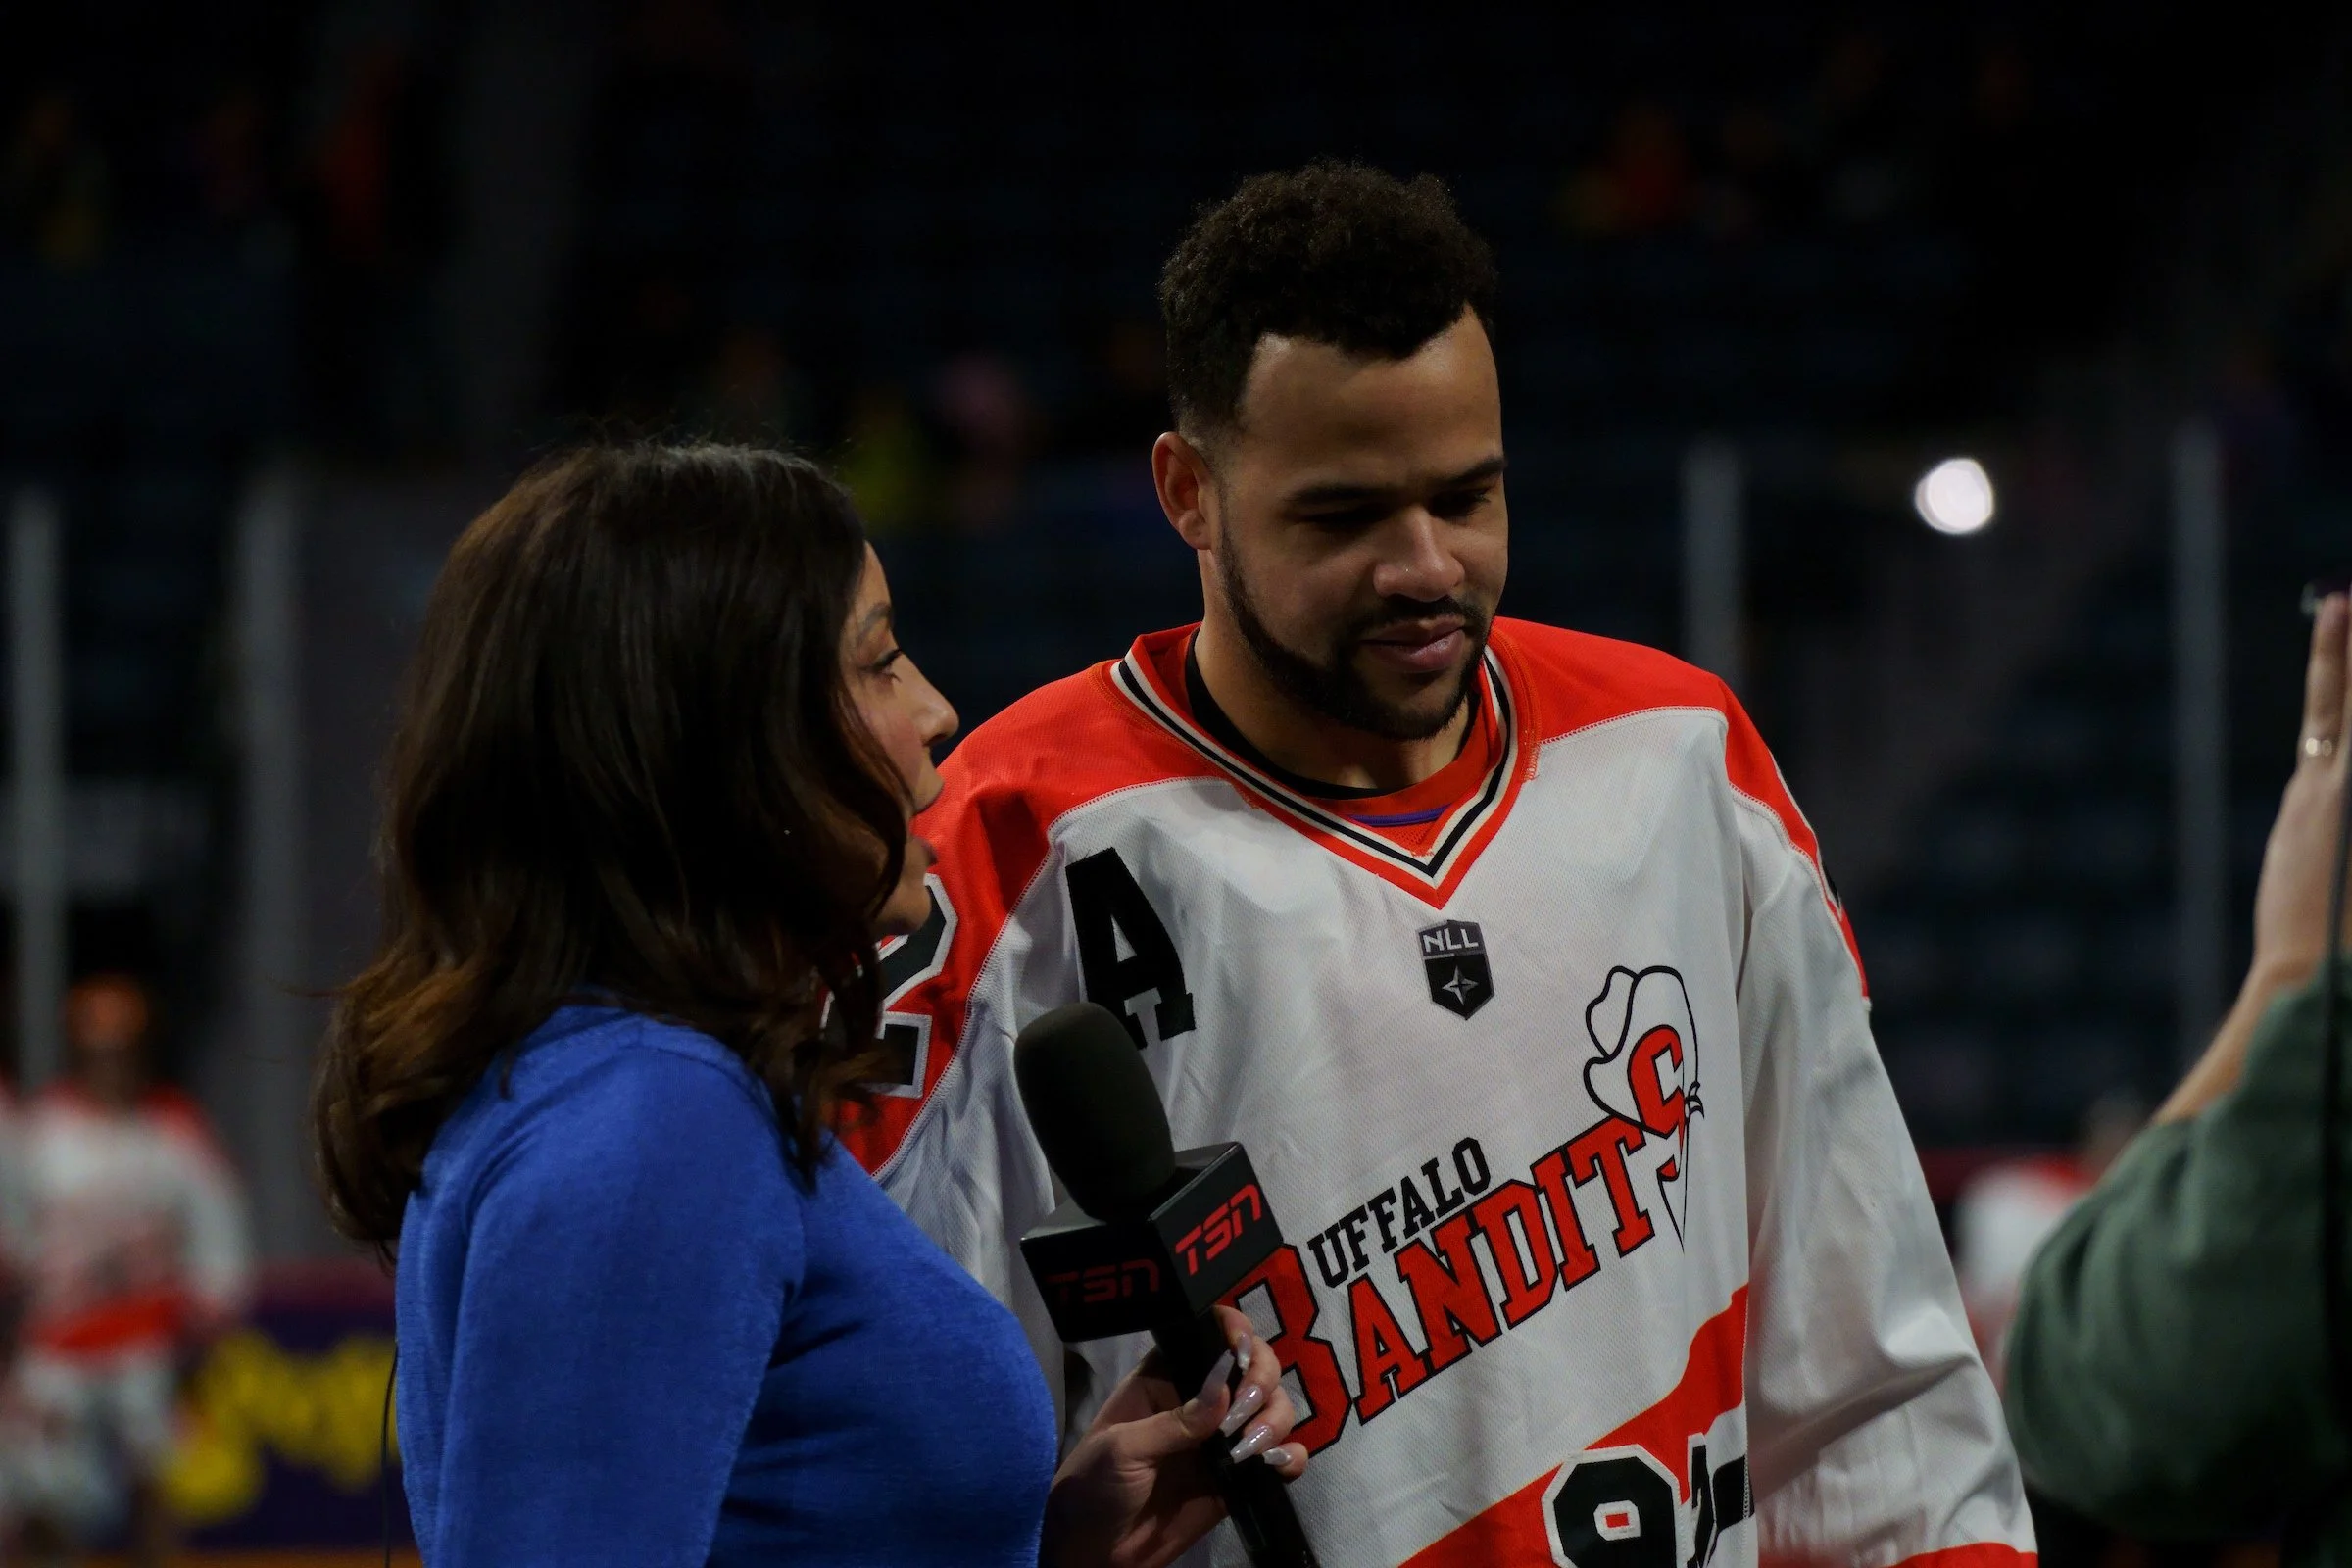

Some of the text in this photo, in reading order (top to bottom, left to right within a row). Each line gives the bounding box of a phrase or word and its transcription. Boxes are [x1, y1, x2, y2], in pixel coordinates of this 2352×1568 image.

[1065, 847, 1196, 1050] A
[1422, 927, 1480, 954] NLL
[1175, 1183, 1263, 1277] TSN
[1041, 1258, 1161, 1311] TSN
